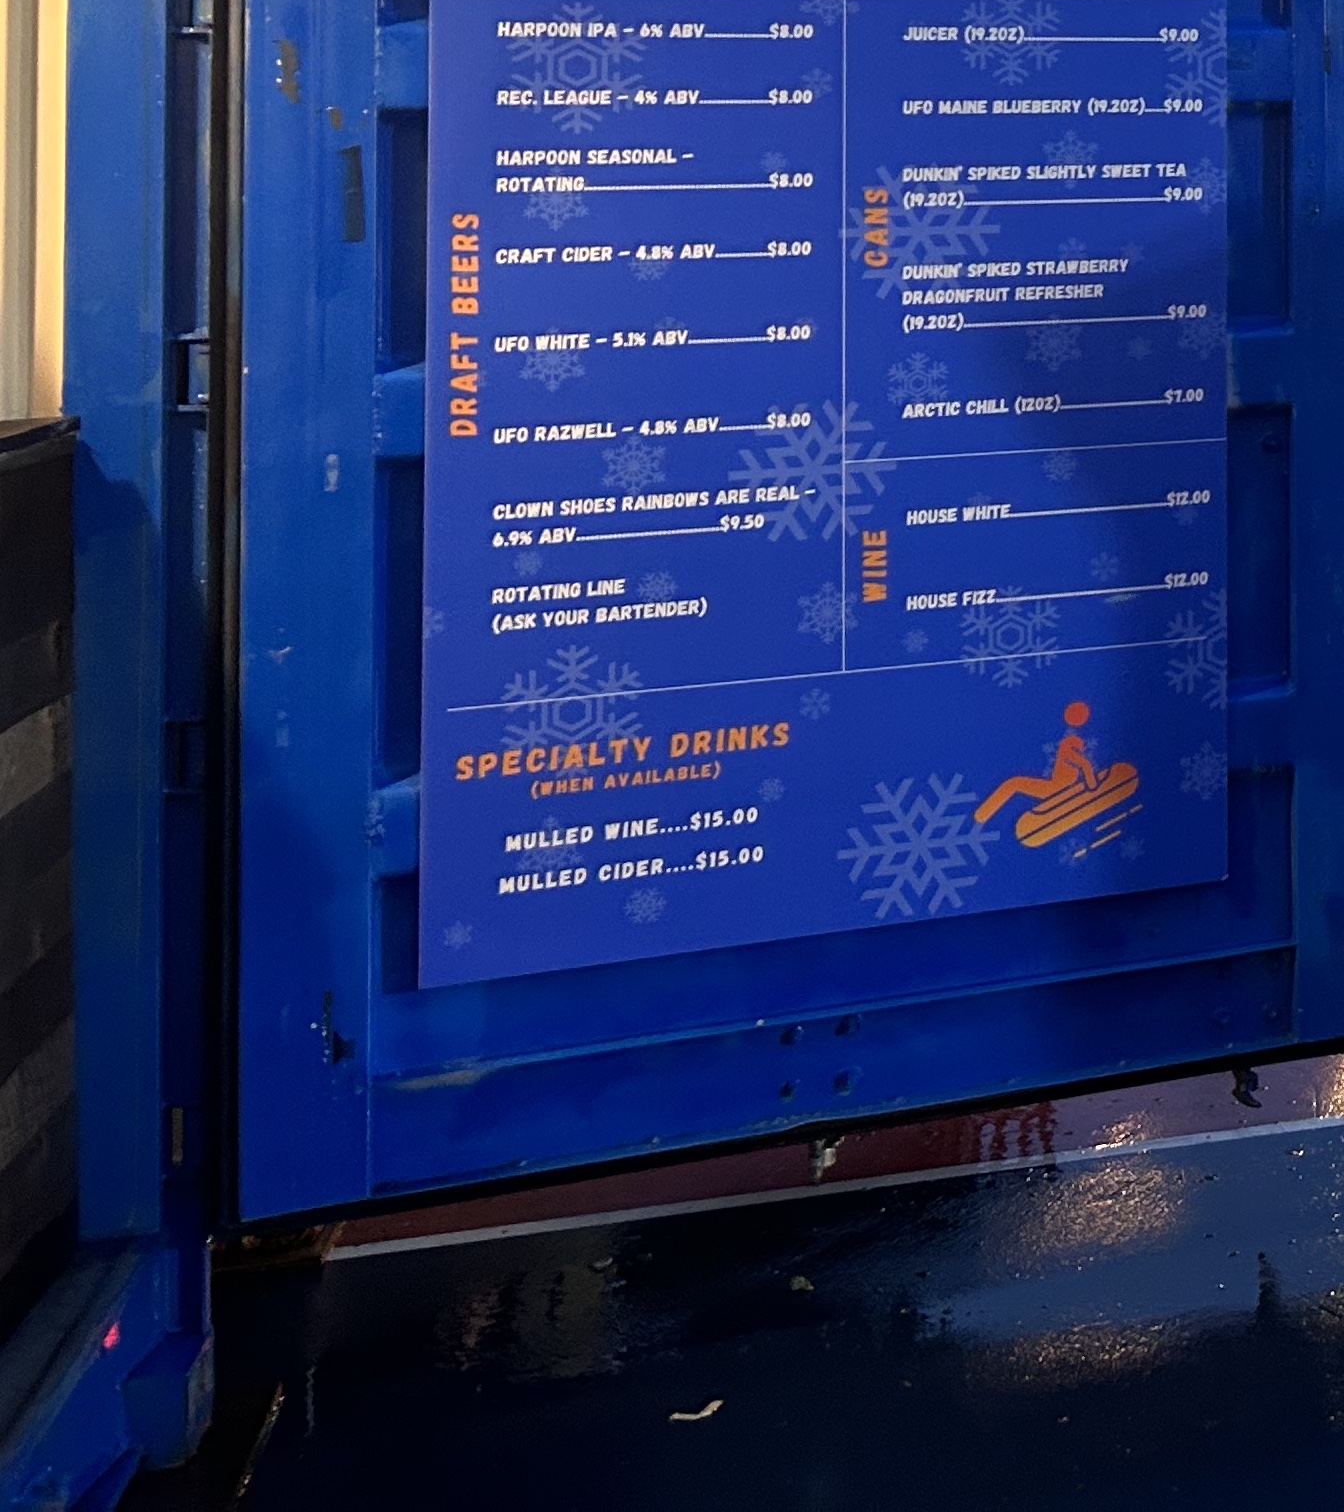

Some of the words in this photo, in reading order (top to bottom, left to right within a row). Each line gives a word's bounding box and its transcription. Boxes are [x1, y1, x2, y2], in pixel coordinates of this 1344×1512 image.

[497, 22, 581, 38] HARPOON
[588, 23, 617, 38] IPA
[639, 24, 663, 38] 6%
[769, 24, 813, 39] $8.00
[904, 27, 958, 41] JUICER
[1160, 28, 1199, 43] $9.00
[496, 90, 537, 105] REC.
[544, 90, 611, 105] LEAGUE
[634, 90, 657, 104] 4%
[769, 89, 812, 105] $8.00
[903, 100, 933, 115] UFO
[938, 100, 987, 114] MAINE
[993, 100, 1081, 114] BLUEBERRY
[1164, 99, 1203, 114] $9.00
[496, 150, 581, 166] HARPOON
[587, 149, 677, 165] SEASONAL
[496, 176, 584, 193] ROTATING
[769, 172, 813, 188] $8.00
[967, 165, 1021, 181] SPIKED
[1026, 164, 1096, 180] SLIGHTLY
[1101, 164, 1151, 179] SWEET
[1157, 163, 1186, 177] TEA
[1164, 187, 1203, 202] $9.00
[865, 188, 889, 268] CANS
[451, 212, 479, 314] BEERS
[496, 248, 556, 264] CRAFT
[562, 246, 612, 263] CIDER
[635, 245, 674, 260] 4.8%
[767, 241, 812, 257] $8.00
[967, 262, 1021, 278] SPIKED
[1026, 259, 1128, 276] STRAWBERRY
[902, 288, 1010, 305] DRAGONFRUIT
[1015, 284, 1104, 301] REFRESHER
[1168, 305, 1206, 320] $9.00
[495, 336, 529, 352] UFO
[536, 334, 590, 350] WHITE
[612, 333, 646, 348] 5.1%
[767, 325, 810, 341] $8.00
[450, 332, 479, 436] DRAFT
[902, 402, 960, 418] ARCTIC
[966, 398, 1009, 414] CHILL
[1015, 395, 1061, 415] (12OZ)
[1164, 388, 1203, 404] $7.00
[494, 427, 528, 444] UFO
[534, 423, 616, 441] RAZWELL
[639, 421, 677, 436] 4.8%
[767, 412, 811, 429] $8.00
[493, 503, 554, 521] CLOWN
[560, 499, 616, 516] SHOES
[621, 493, 709, 512] RAINBOWS
[715, 489, 750, 505] ARE
[755, 486, 798, 502] REAL
[907, 507, 957, 525] HOUSE
[962, 504, 1011, 521] WHITE
[1167, 490, 1210, 506] $12.00
[493, 531, 533, 547] 6.9%
[721, 515, 764, 532] $9.50
[863, 530, 887, 602] WINE
[492, 583, 581, 604] ROTATING
[587, 579, 626, 596] LINE
[907, 592, 957, 611] HOUSE
[962, 589, 996, 606] FIZZ
[1165, 571, 1208, 588] $12.00
[492, 613, 536, 635] (ASK
[542, 609, 589, 627] YOUR
[595, 597, 708, 624] BARTENDER)
[455, 737, 652, 781] SPECIALTY
[670, 722, 790, 758] DRINKS
[530, 777, 593, 800] (WHEN
[604, 761, 722, 789] AVAILABLE)
[505, 826, 593, 852] MULLED
[499, 865, 587, 894] MULLED
